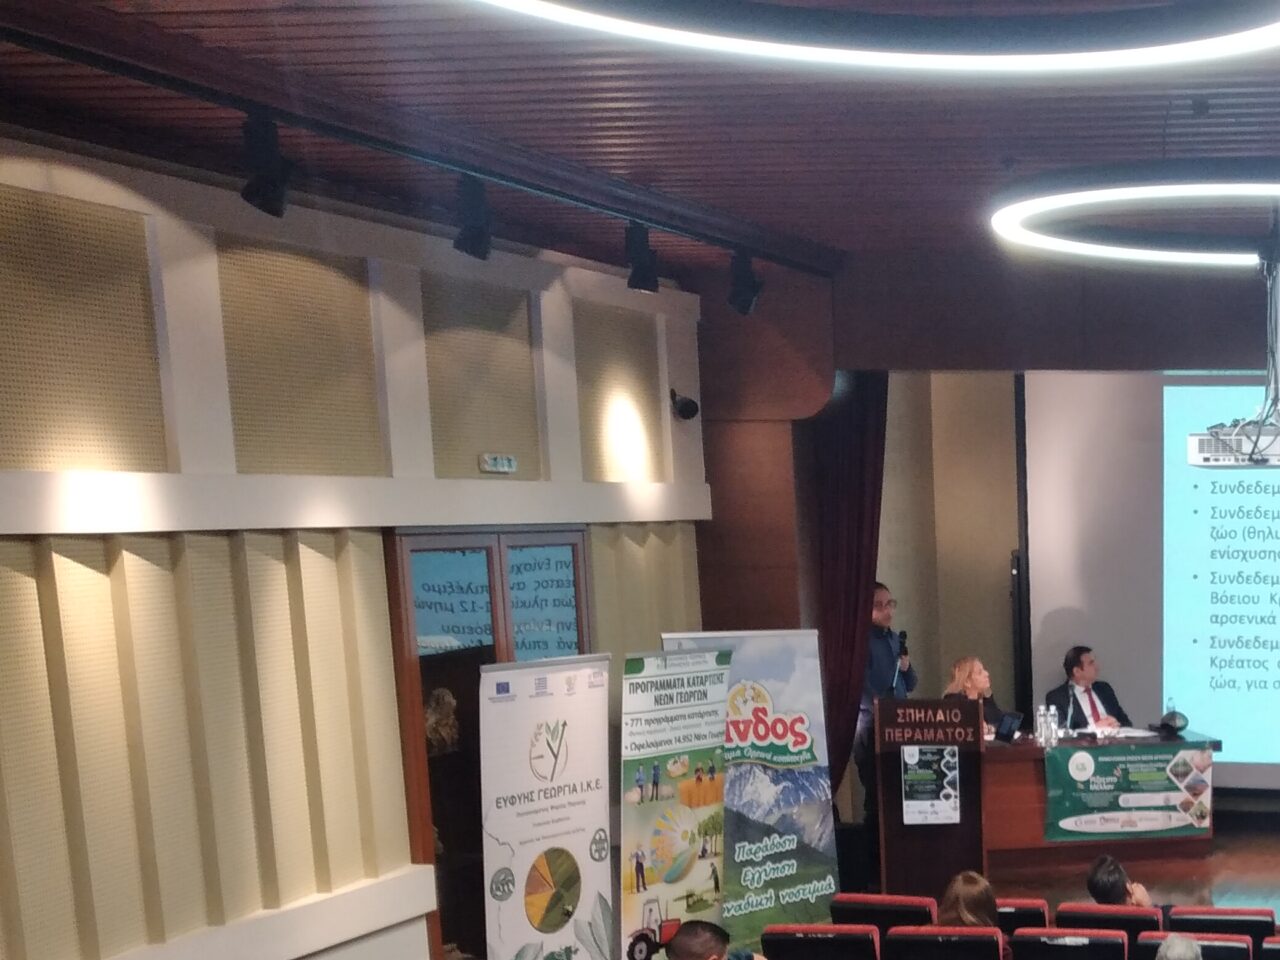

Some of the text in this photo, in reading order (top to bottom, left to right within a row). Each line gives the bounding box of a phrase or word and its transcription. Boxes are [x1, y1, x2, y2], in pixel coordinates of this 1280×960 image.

[1210, 525, 1237, 542] ζώο
[1210, 591, 1260, 605] Βόειου
[1209, 610, 1276, 626] αρσενικά
[1209, 655, 1269, 671] Κρέατος
[629, 677, 685, 695] ΠΡΟΓΡΑΜΜΑΤΑ
[1245, 678, 1268, 692] για
[654, 689, 708, 706] ΝΕΩΝ ΓΕΩΡΓΩΝ
[896, 708, 961, 723] ΣΠΗΛΑΙΟ
[725, 707, 807, 748] ίνδος
[885, 728, 974, 741] ΠΕΡΑΜΑΤΟΣ
[496, 790, 535, 809] ΕΥΦΥΗΣ
[538, 782, 578, 800] ΓΕΩΡΓΙΑ
[735, 834, 797, 862] Παράδοση
[741, 860, 797, 889] Εγγύηση
[723, 889, 775, 917] ναδική
